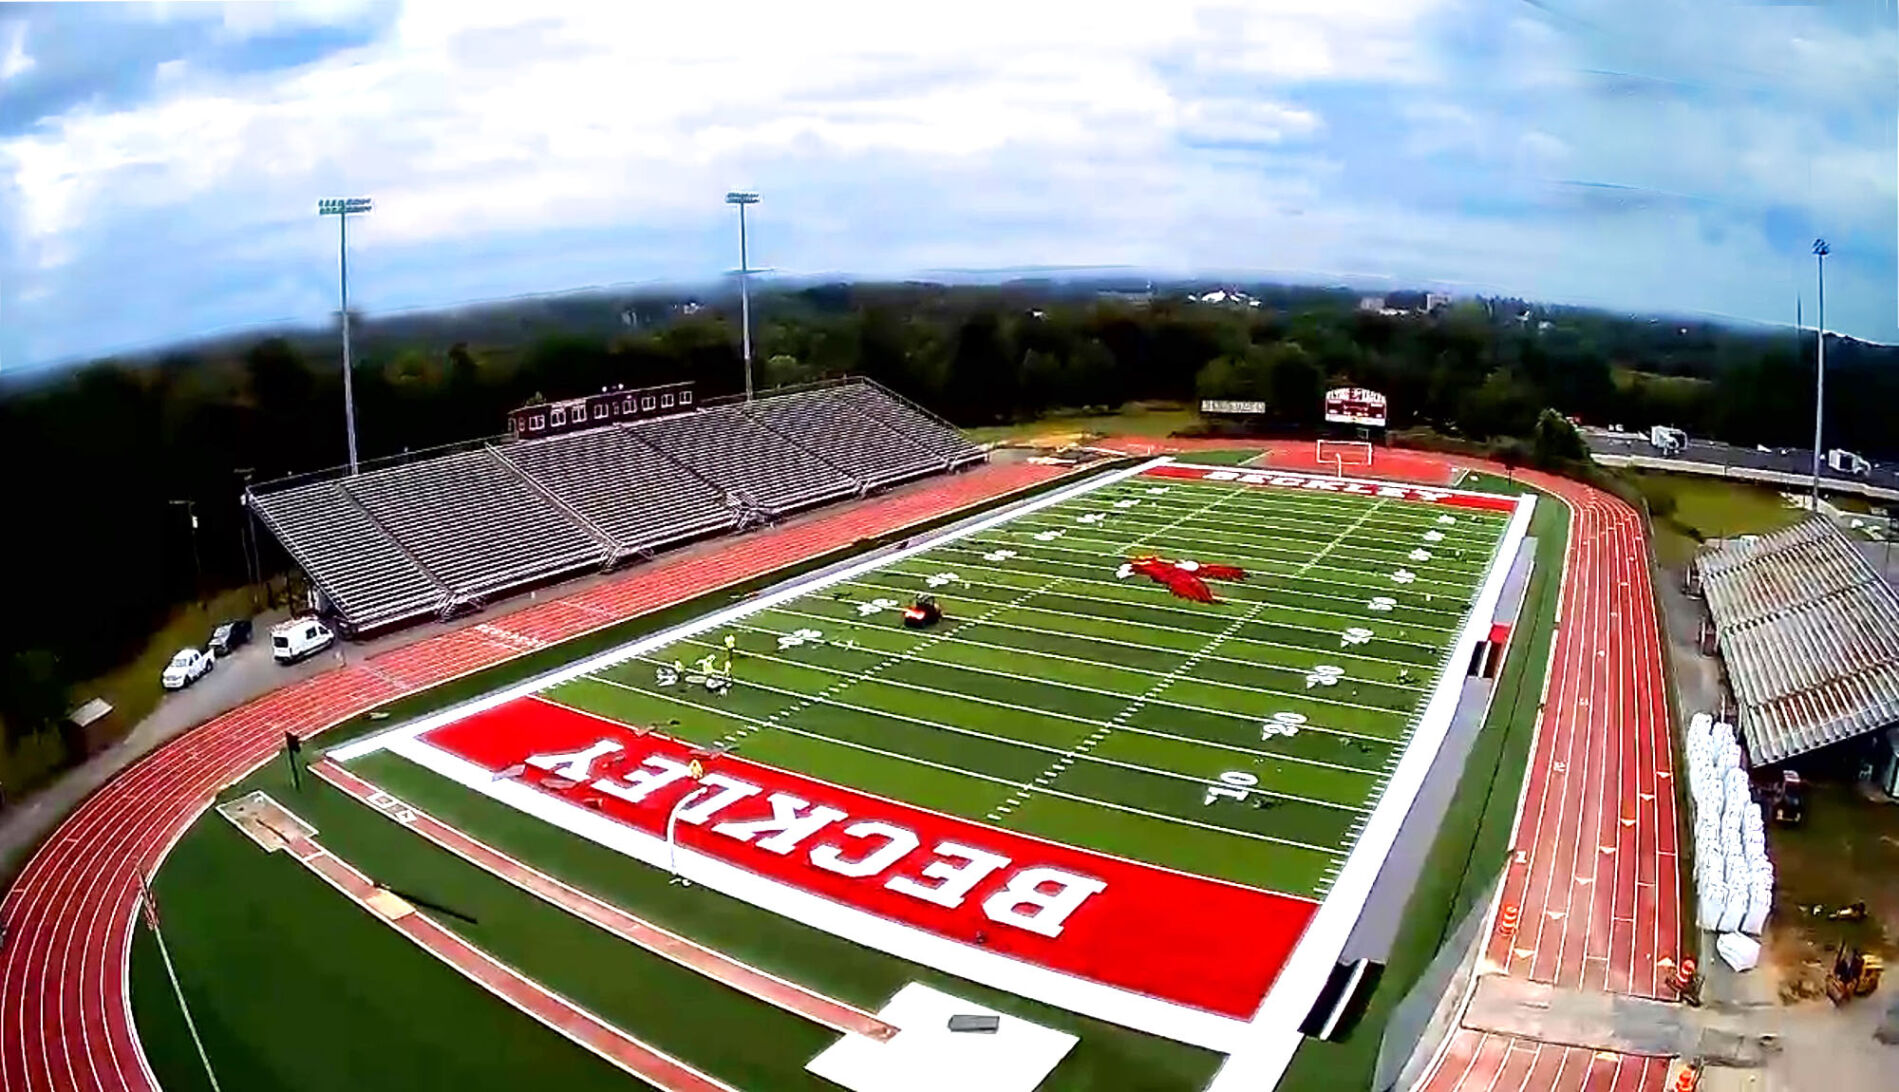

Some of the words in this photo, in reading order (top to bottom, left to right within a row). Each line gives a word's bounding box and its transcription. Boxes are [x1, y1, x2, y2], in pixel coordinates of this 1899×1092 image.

[1263, 712, 1307, 737] 20
[1208, 771, 1258, 801] 10
[524, 739, 1109, 939] BECKLEY
